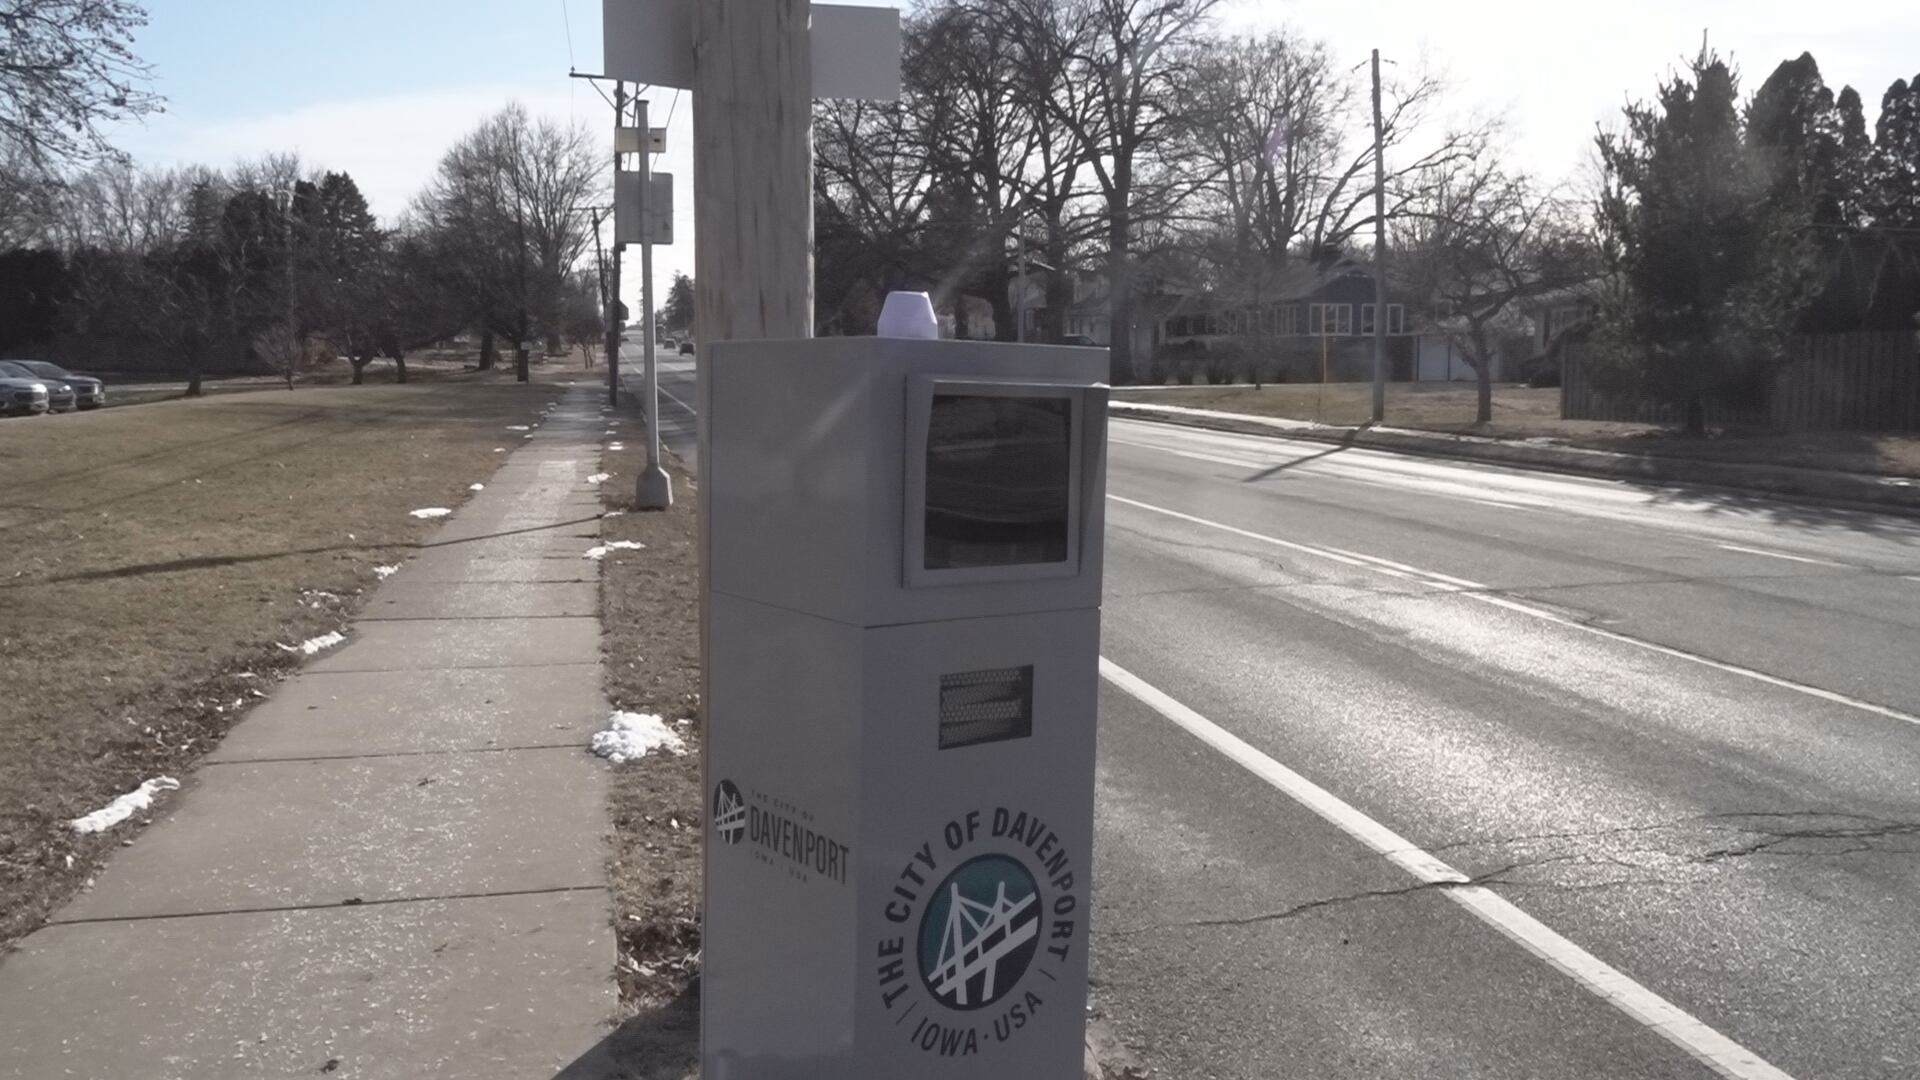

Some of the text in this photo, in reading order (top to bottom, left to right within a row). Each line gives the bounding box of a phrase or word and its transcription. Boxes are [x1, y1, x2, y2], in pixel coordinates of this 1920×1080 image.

[750, 804, 849, 885] DAVENPORT
[877, 806, 1076, 1009] THE CITY OF DAVENPORT
[911, 990, 1043, 1057] IOWA USA
